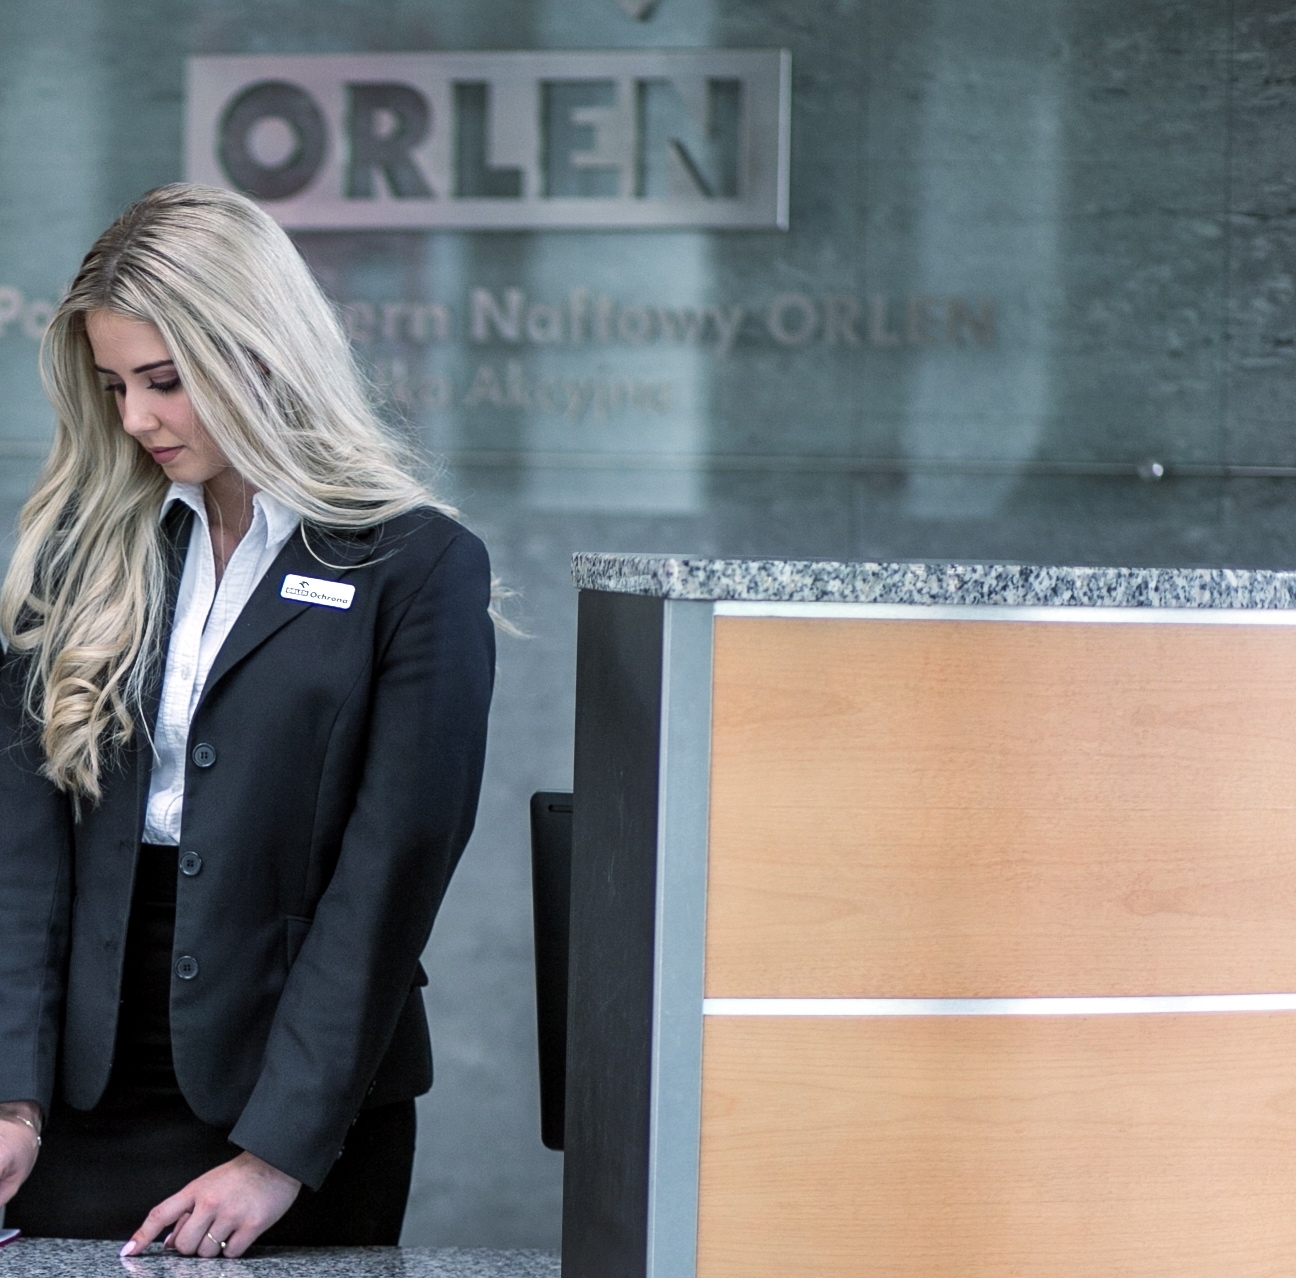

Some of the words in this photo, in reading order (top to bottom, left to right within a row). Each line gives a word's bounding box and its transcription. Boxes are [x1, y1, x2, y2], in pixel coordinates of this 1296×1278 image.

[216, 78, 742, 200] ORLEN
[470, 283, 745, 358] Naftowy
[767, 293, 998, 350] ORLEN
[310, 592, 348, 604] Ochrona
